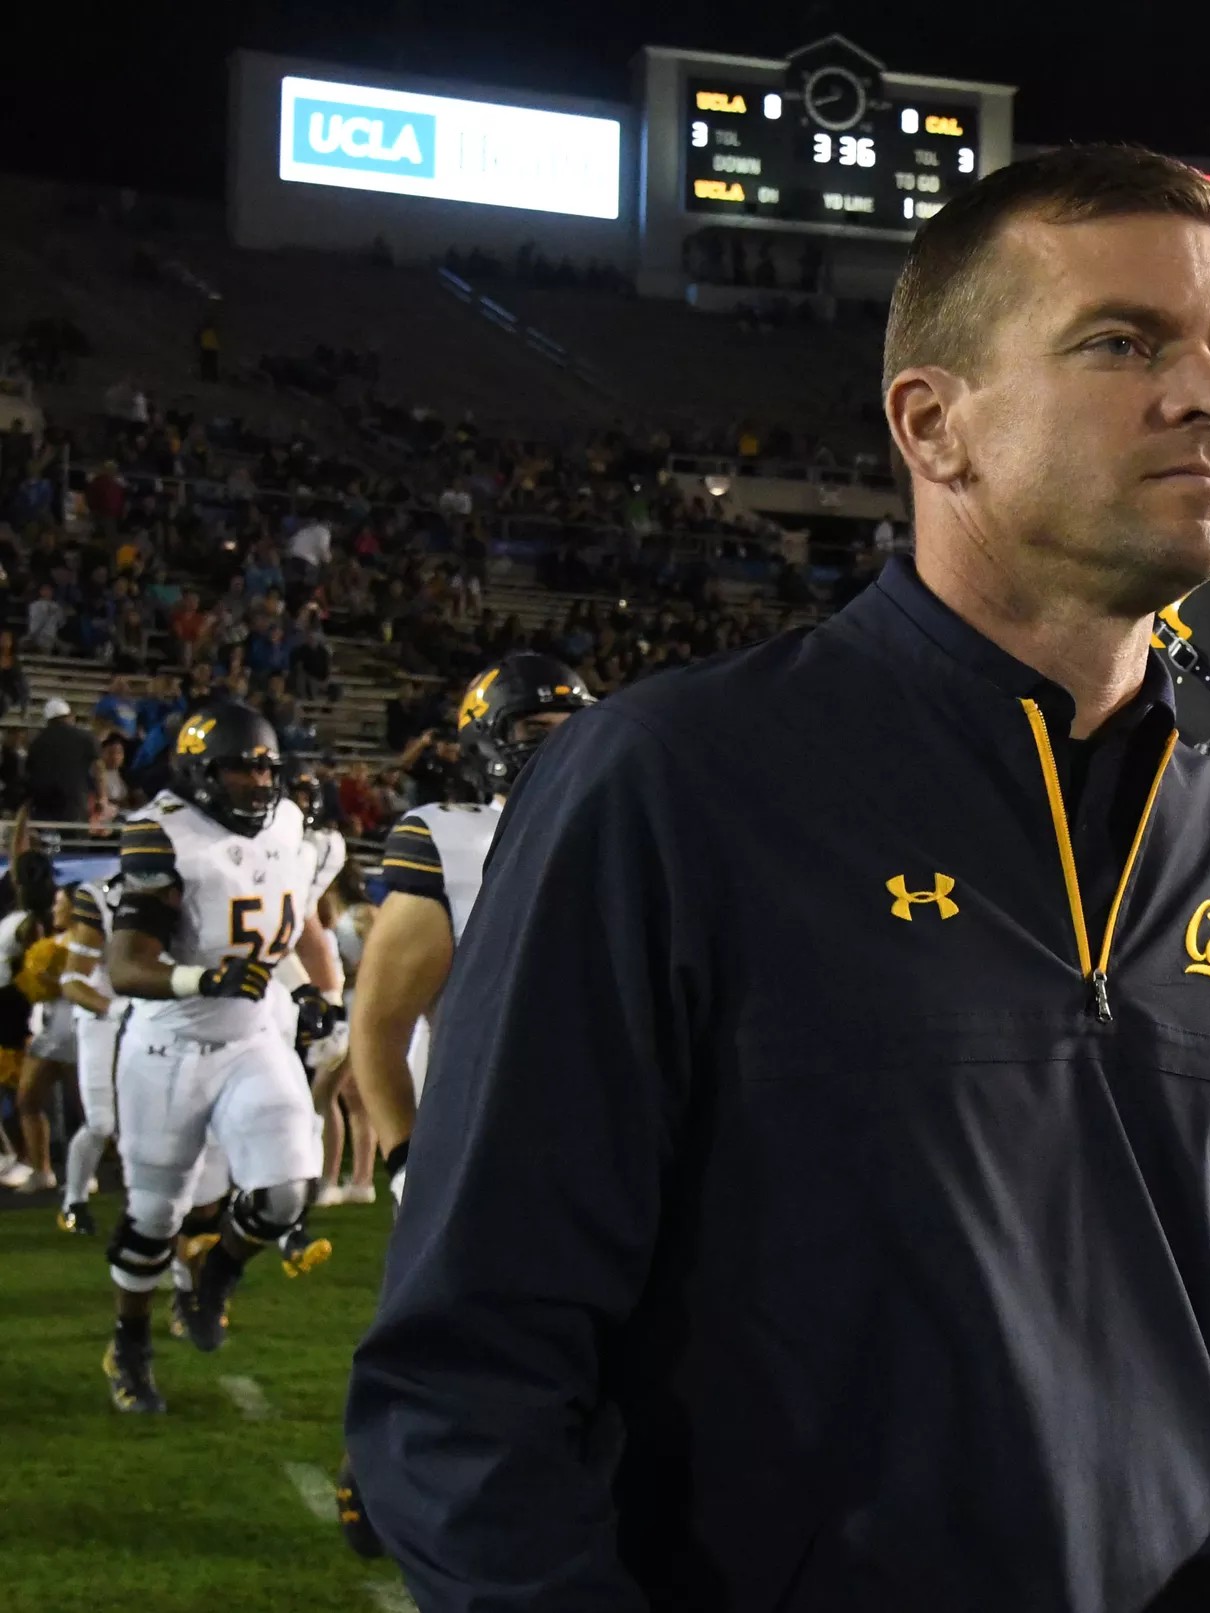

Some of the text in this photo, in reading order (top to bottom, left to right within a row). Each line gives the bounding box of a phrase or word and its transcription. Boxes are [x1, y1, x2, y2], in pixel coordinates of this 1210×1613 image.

[308, 112, 423, 165] UCLA
[692, 121, 708, 147] 3
[958, 148, 974, 173] 3
[228, 889, 294, 962] 54
